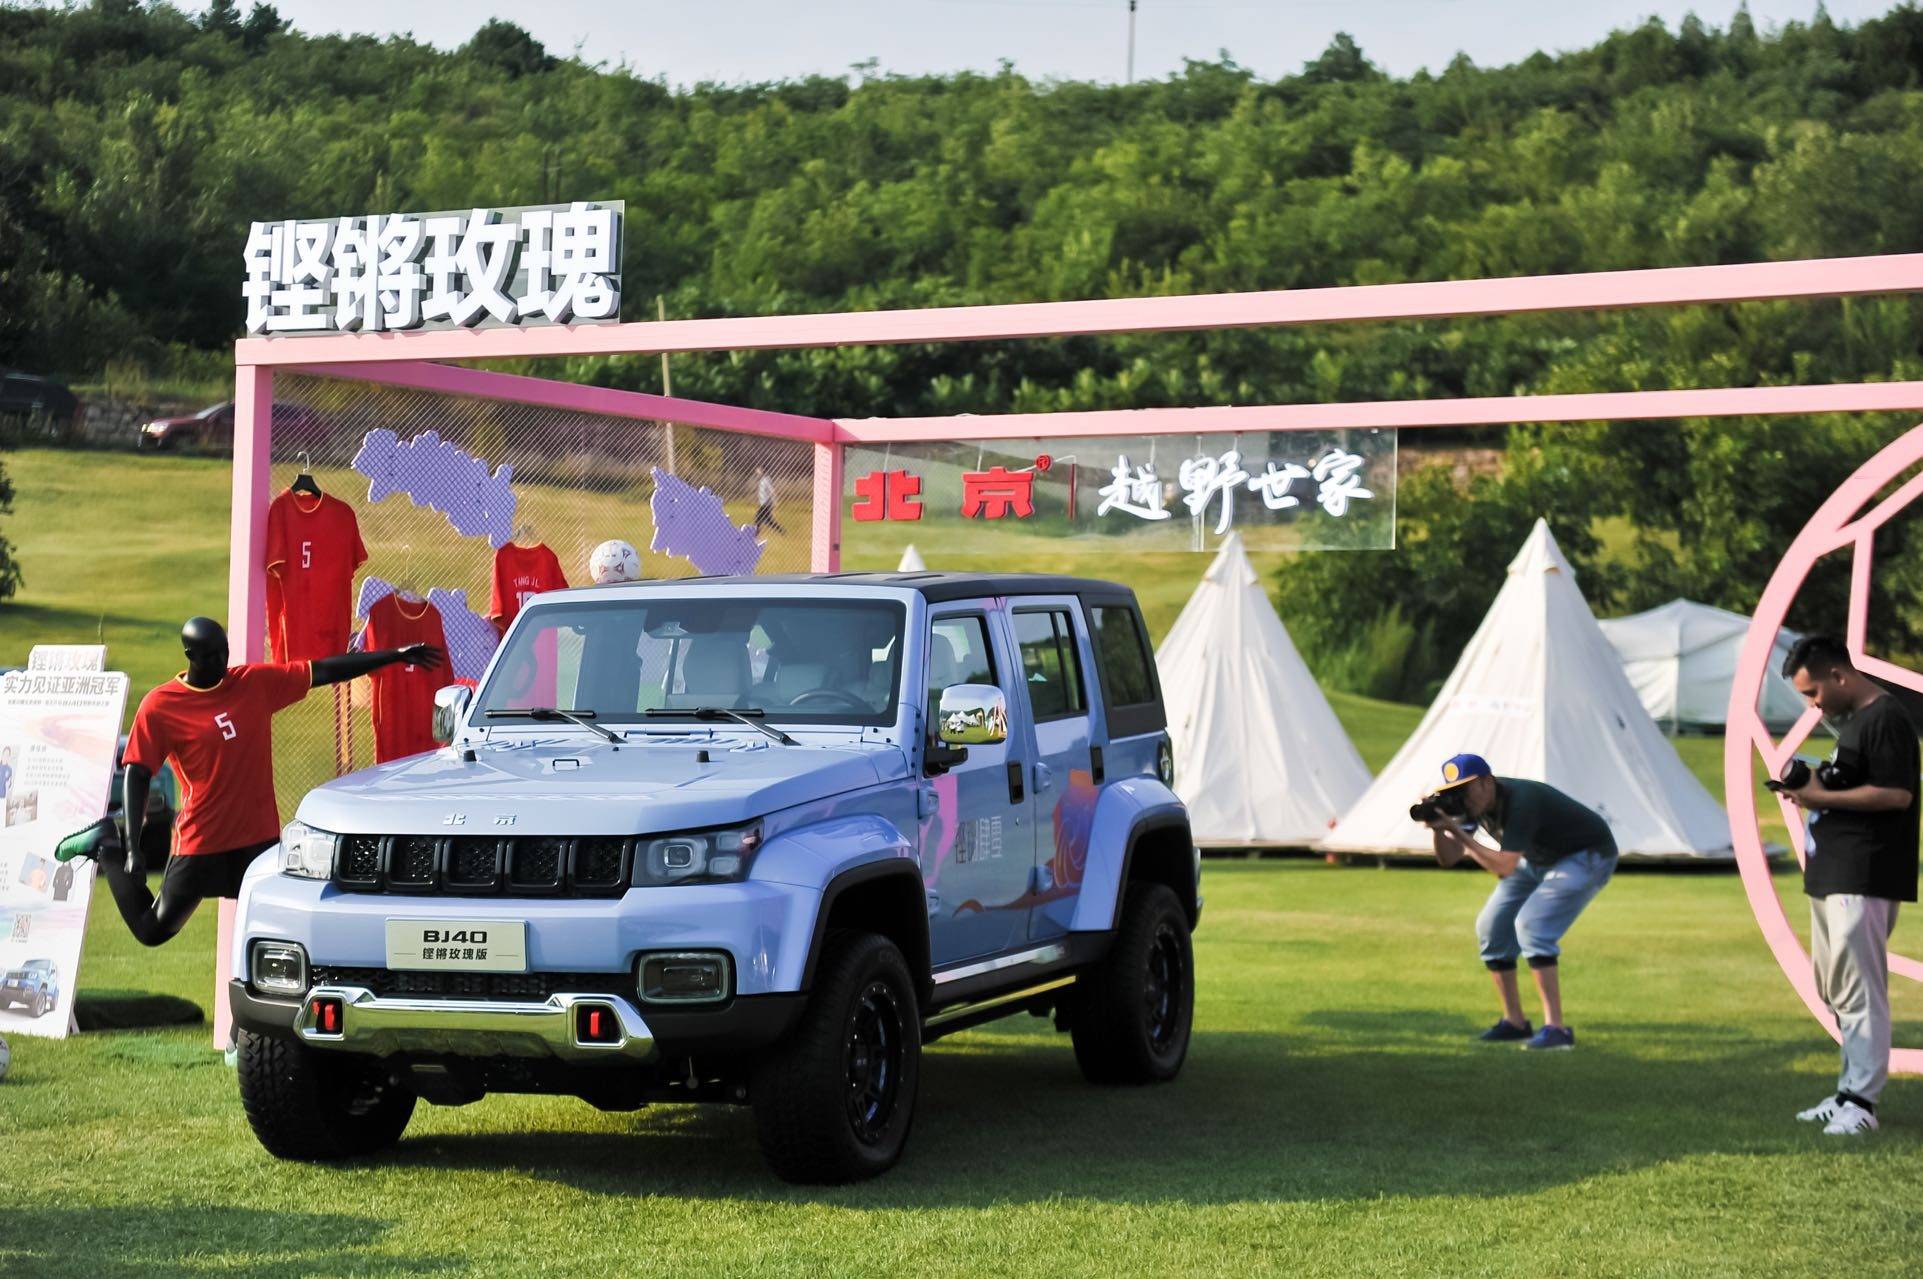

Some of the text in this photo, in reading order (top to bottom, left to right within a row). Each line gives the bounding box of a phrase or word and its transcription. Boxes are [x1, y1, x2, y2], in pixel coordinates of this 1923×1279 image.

[242, 201, 616, 334] 铿锵玫瑰
[1097, 448, 1375, 535] 越野世家
[302, 542, 312, 569] 5
[4, 675, 121, 695] 实力见证亚洲冠军
[214, 712, 237, 741] 5
[423, 930, 488, 944] BJ40
[422, 946, 488, 961] 铿锵玫瑰版
